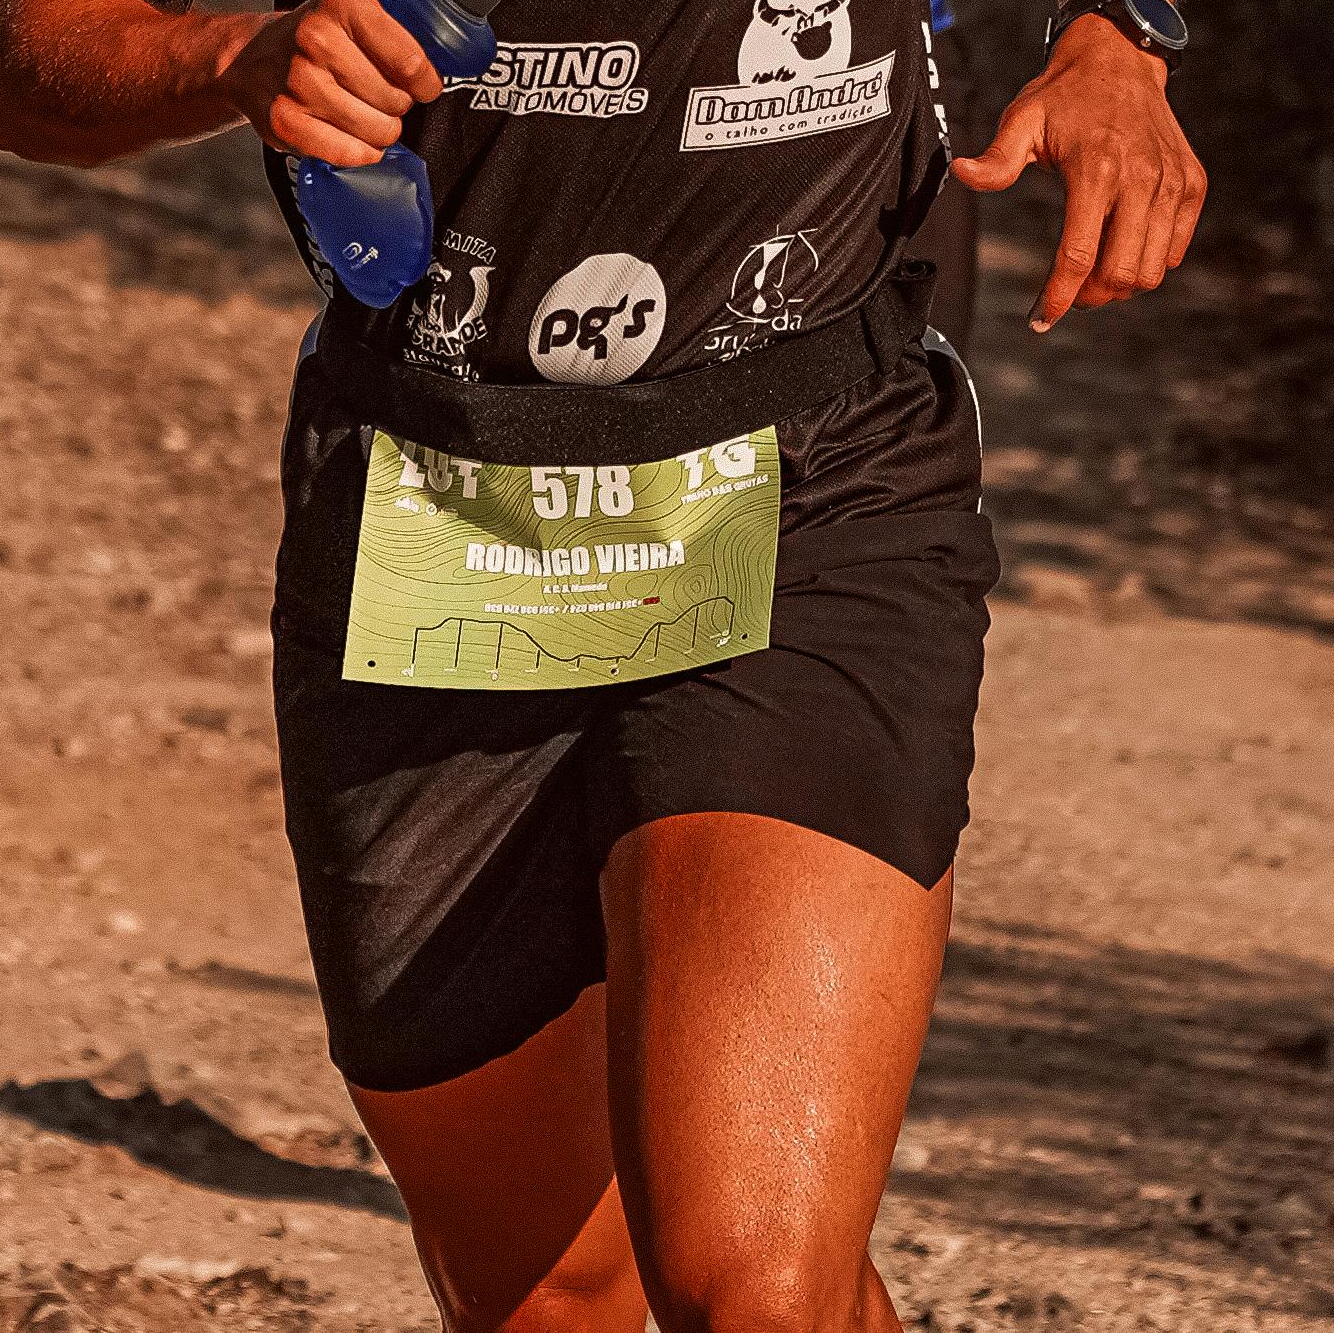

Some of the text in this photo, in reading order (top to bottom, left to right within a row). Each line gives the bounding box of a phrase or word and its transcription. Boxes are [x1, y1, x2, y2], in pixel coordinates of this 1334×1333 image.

[444, 47, 635, 90] STINO
[473, 87, 646, 115] AUTOMÓVEIS
[695, 71, 883, 125] Dom André
[705, 104, 873, 141] o talho com tradição
[675, 433, 757, 492] TG
[529, 466, 635, 521] 578
[465, 539, 686, 577] RODRIGO VIEIRA
